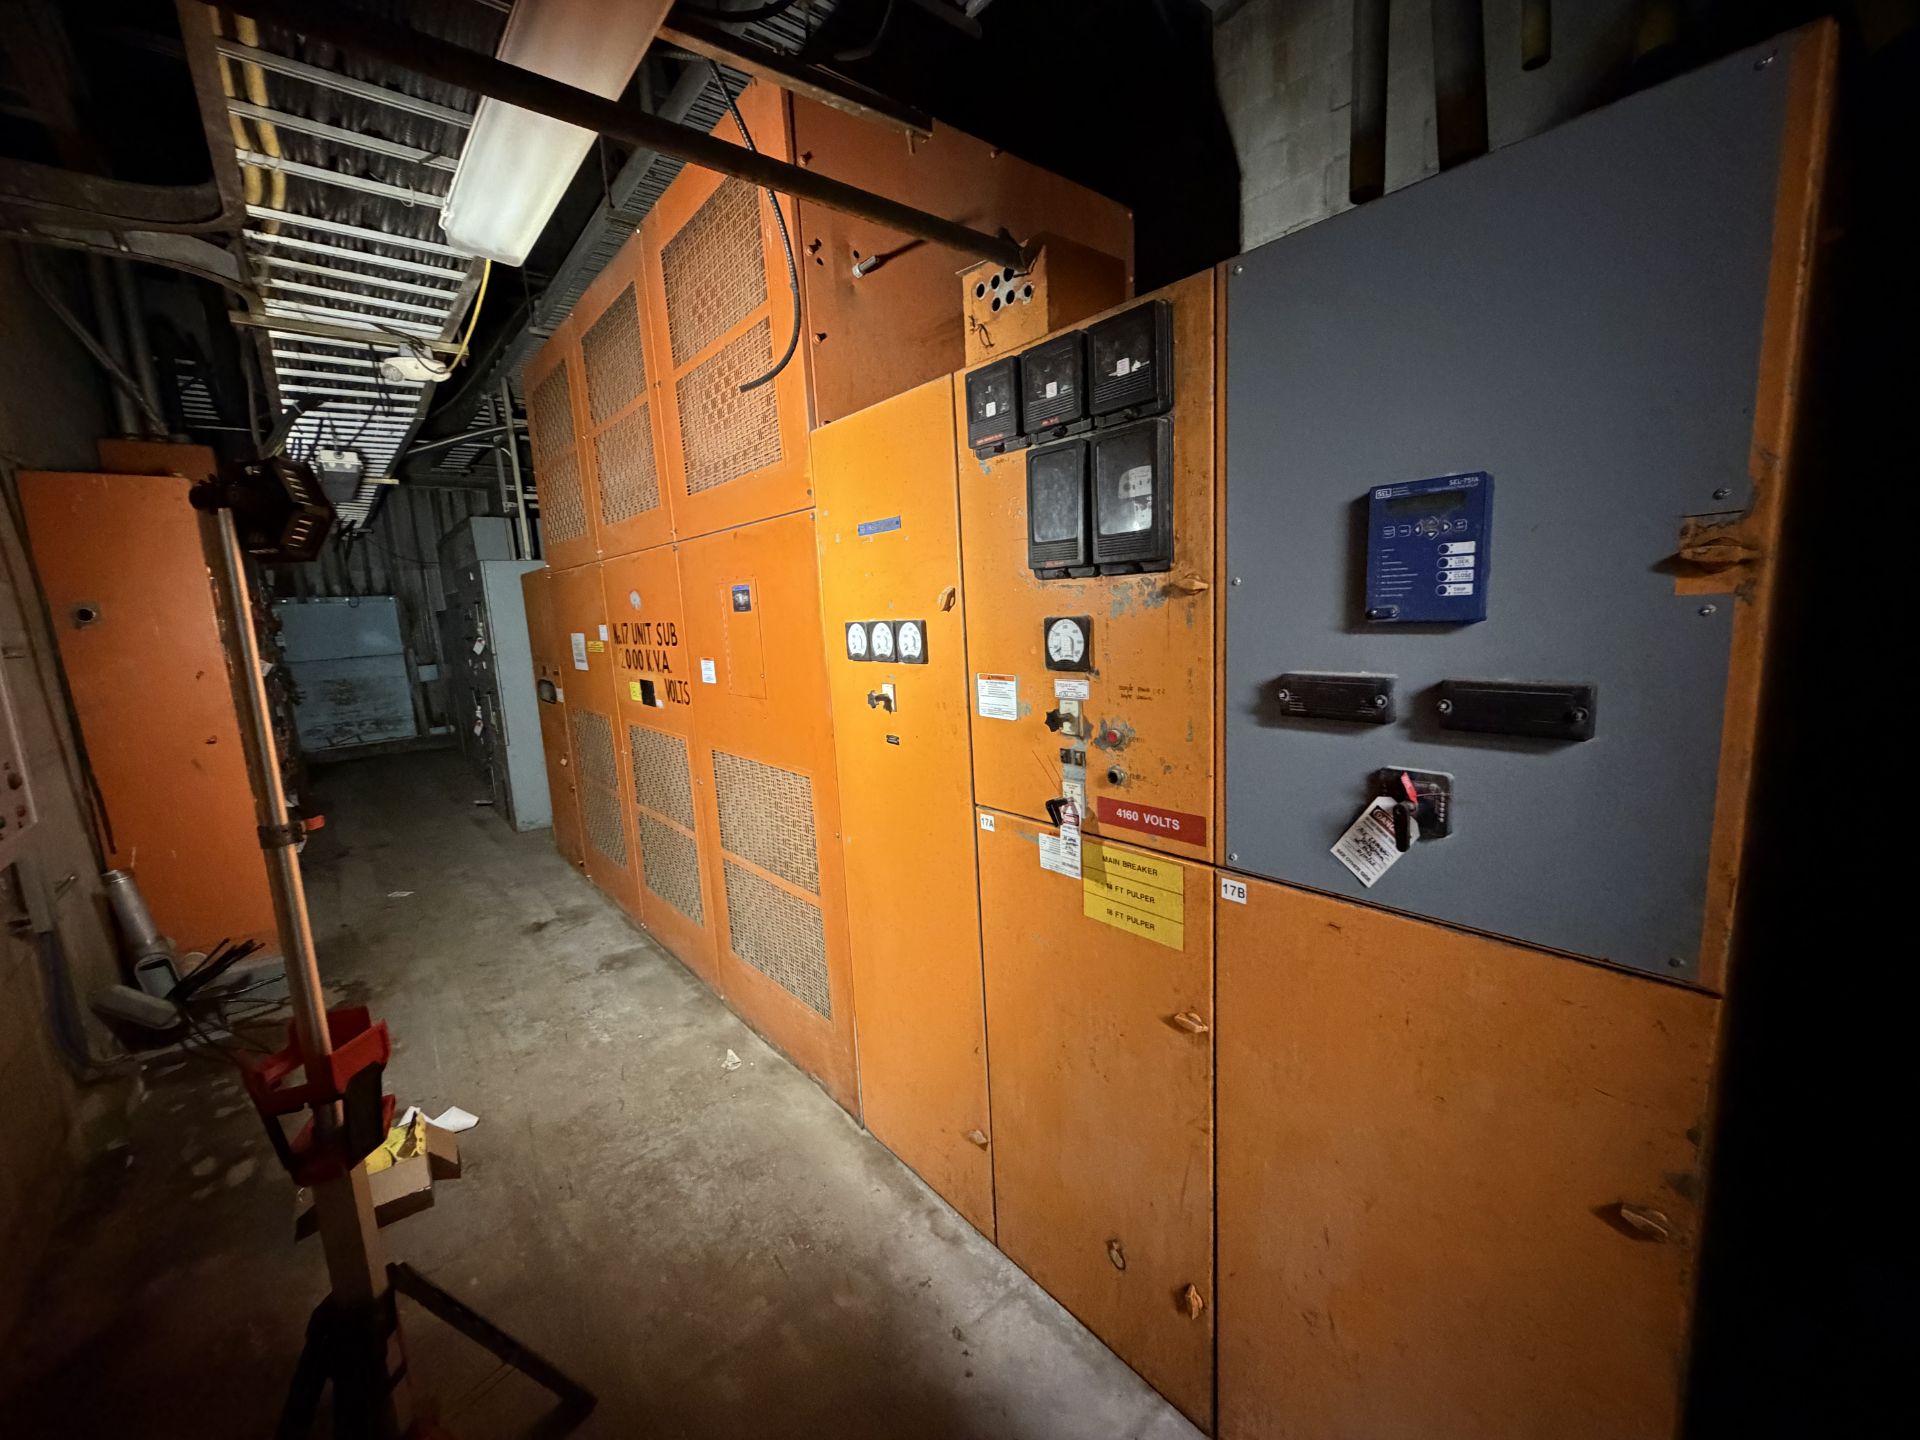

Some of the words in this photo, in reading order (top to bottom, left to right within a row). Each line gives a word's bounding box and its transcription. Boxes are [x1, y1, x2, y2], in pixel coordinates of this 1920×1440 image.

[631, 622, 652, 646] UNIT
[656, 622, 678, 647] SUB
[664, 678, 691, 706] VOLTS
[981, 816, 994, 828] 17A
[1116, 808, 1139, 822] 4160
[1143, 812, 1180, 831] VOLTS
[1102, 855, 1121, 867] MAIN
[1122, 860, 1158, 877] BREAKER
[1115, 885, 1124, 895] FT
[1126, 889, 1156, 904] PULPER
[1222, 883, 1246, 899] 17B
[1115, 911, 1124, 919] FT
[1126, 915, 1156, 932] PULPER
